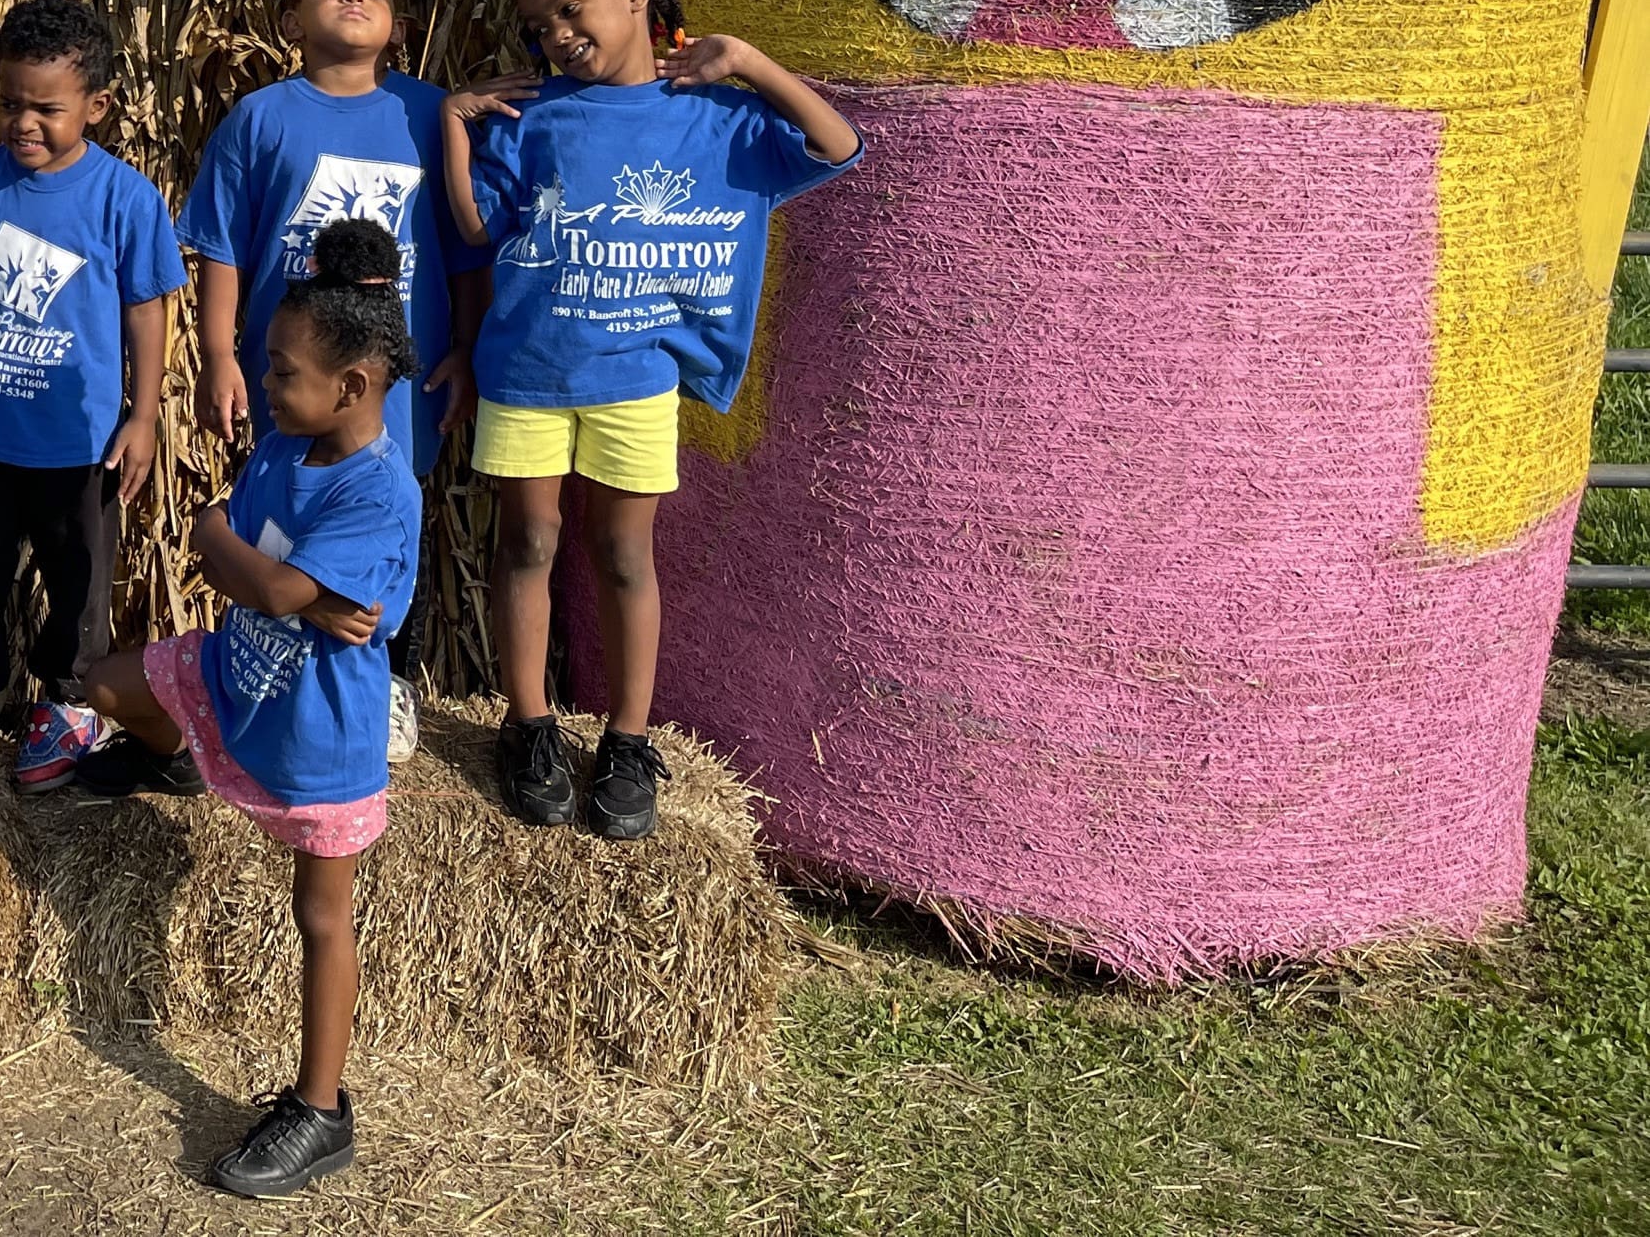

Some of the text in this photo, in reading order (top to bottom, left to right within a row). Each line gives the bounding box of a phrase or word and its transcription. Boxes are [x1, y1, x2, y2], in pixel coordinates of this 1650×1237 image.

[558, 203, 746, 231] A Promising
[562, 228, 738, 268] Tomorrow
[560, 268, 734, 303] Early Care & Educational Center
[552, 306, 570, 317] 890
[573, 308, 586, 319] W.
[588, 306, 631, 320] Bancroft
[34, 357, 62, 366] Center
[14, 377, 50, 390] 43606
